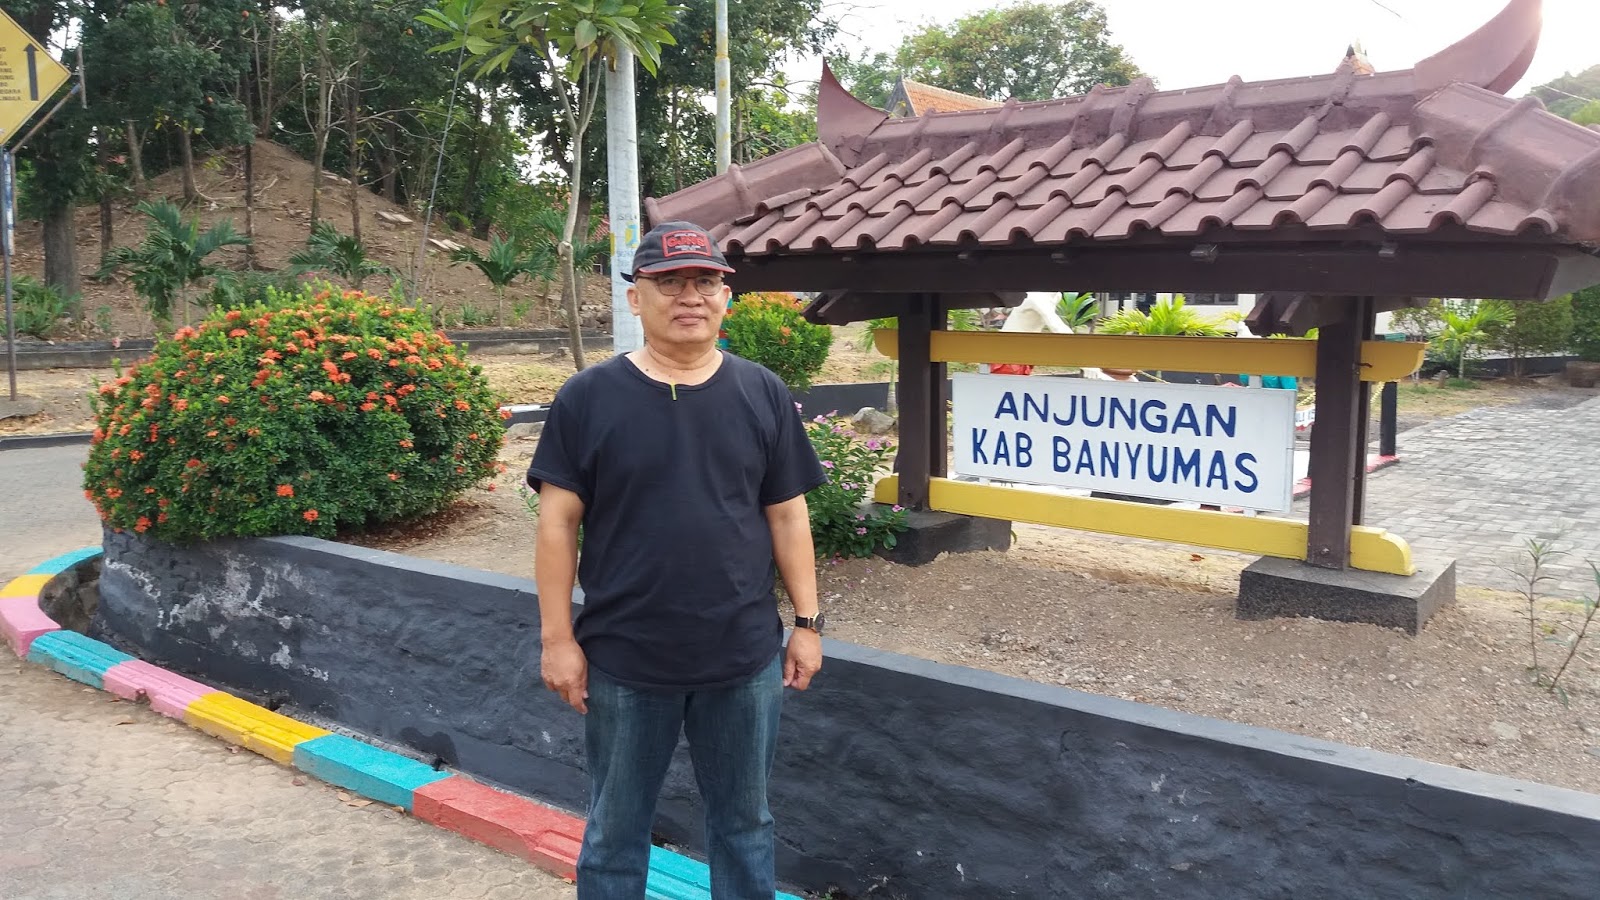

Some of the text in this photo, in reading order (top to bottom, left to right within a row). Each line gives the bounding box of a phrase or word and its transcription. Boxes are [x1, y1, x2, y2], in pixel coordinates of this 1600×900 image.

[994, 391, 1236, 438] ANJUNGAN
[972, 427, 1259, 493] KAB BANYUMAS
